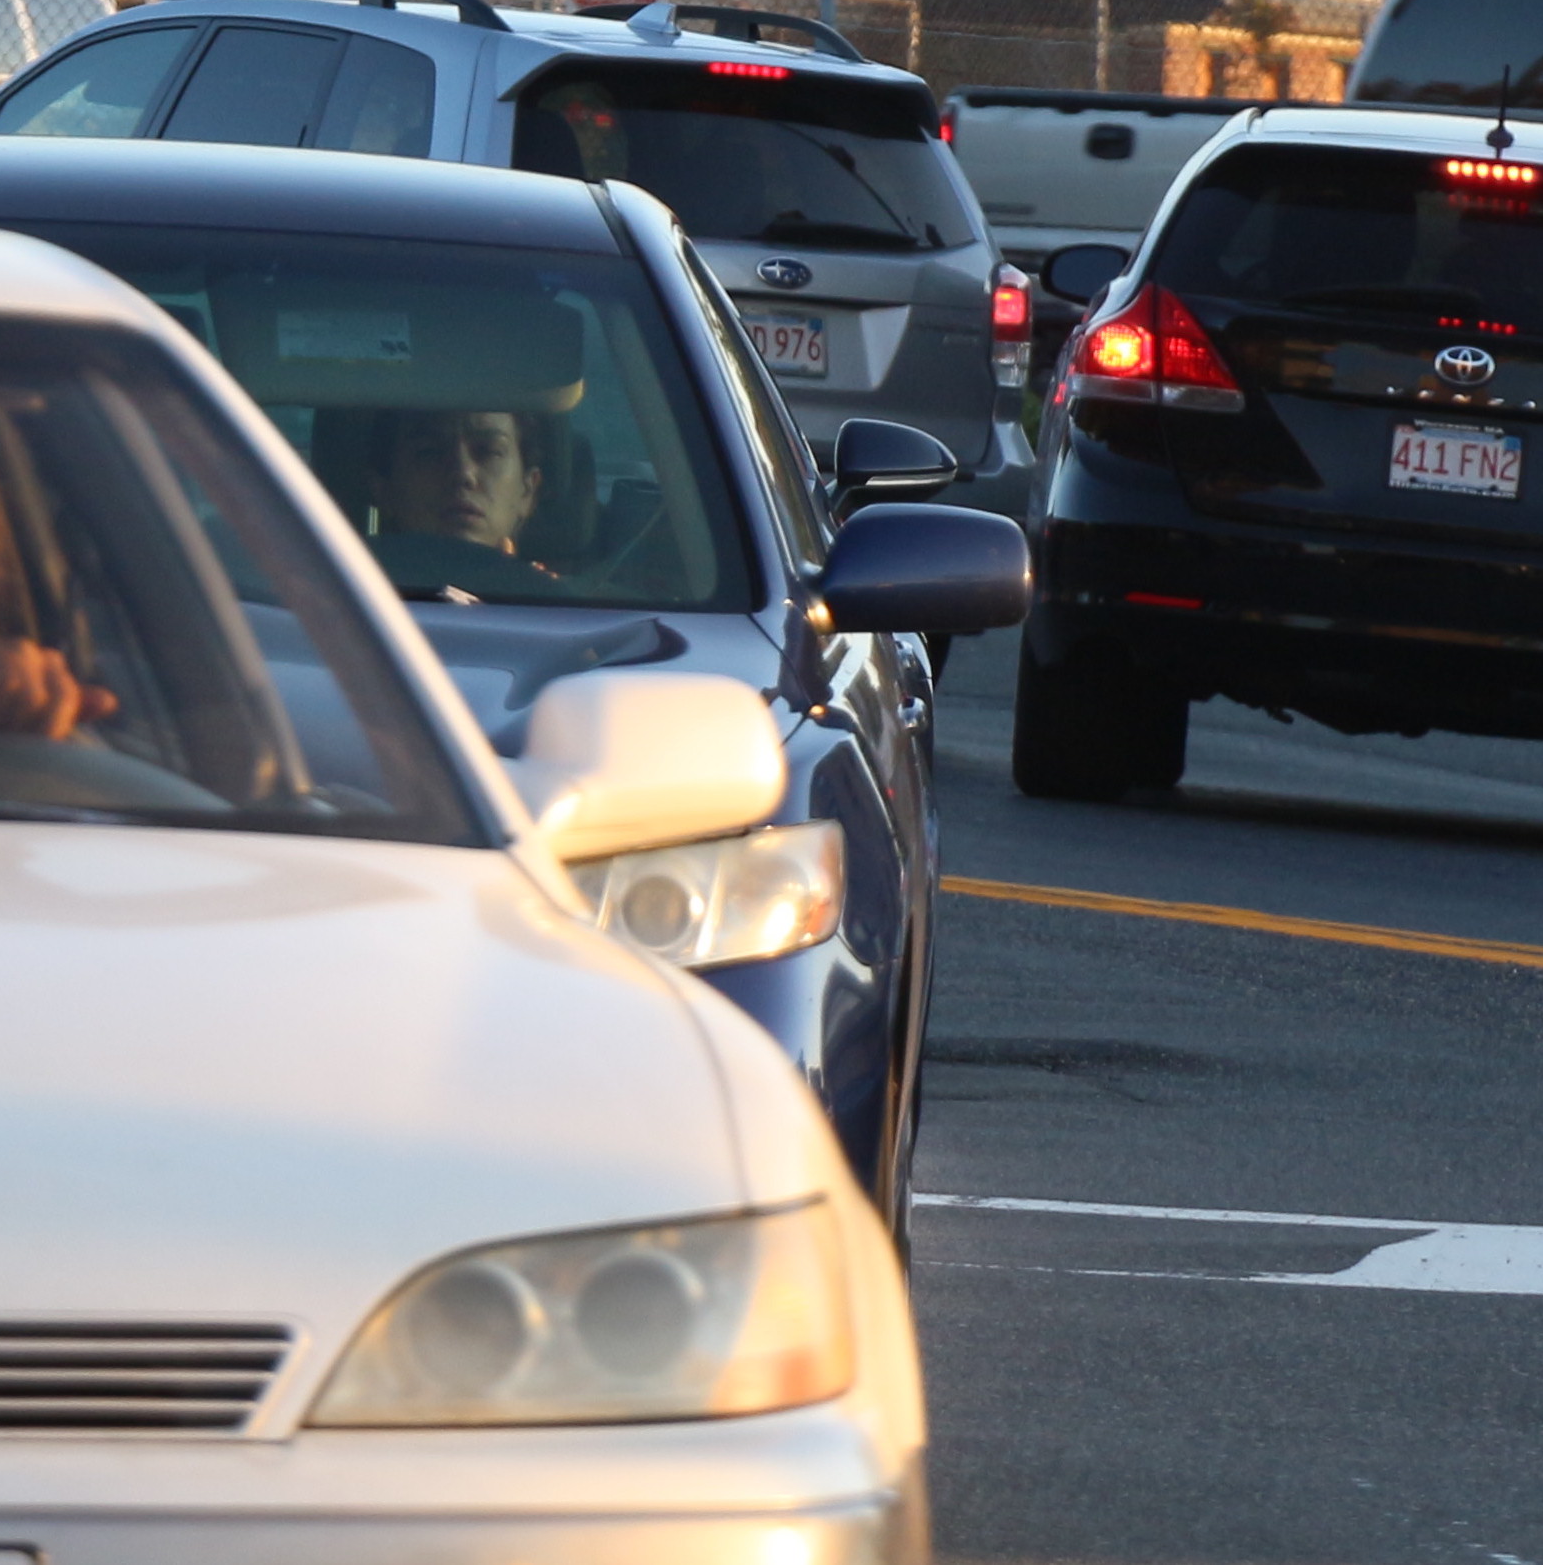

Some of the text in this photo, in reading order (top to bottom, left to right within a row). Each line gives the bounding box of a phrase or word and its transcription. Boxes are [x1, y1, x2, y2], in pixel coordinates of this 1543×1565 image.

[775, 327, 821, 361] 976
[1393, 437, 1520, 482] 411 FN2
